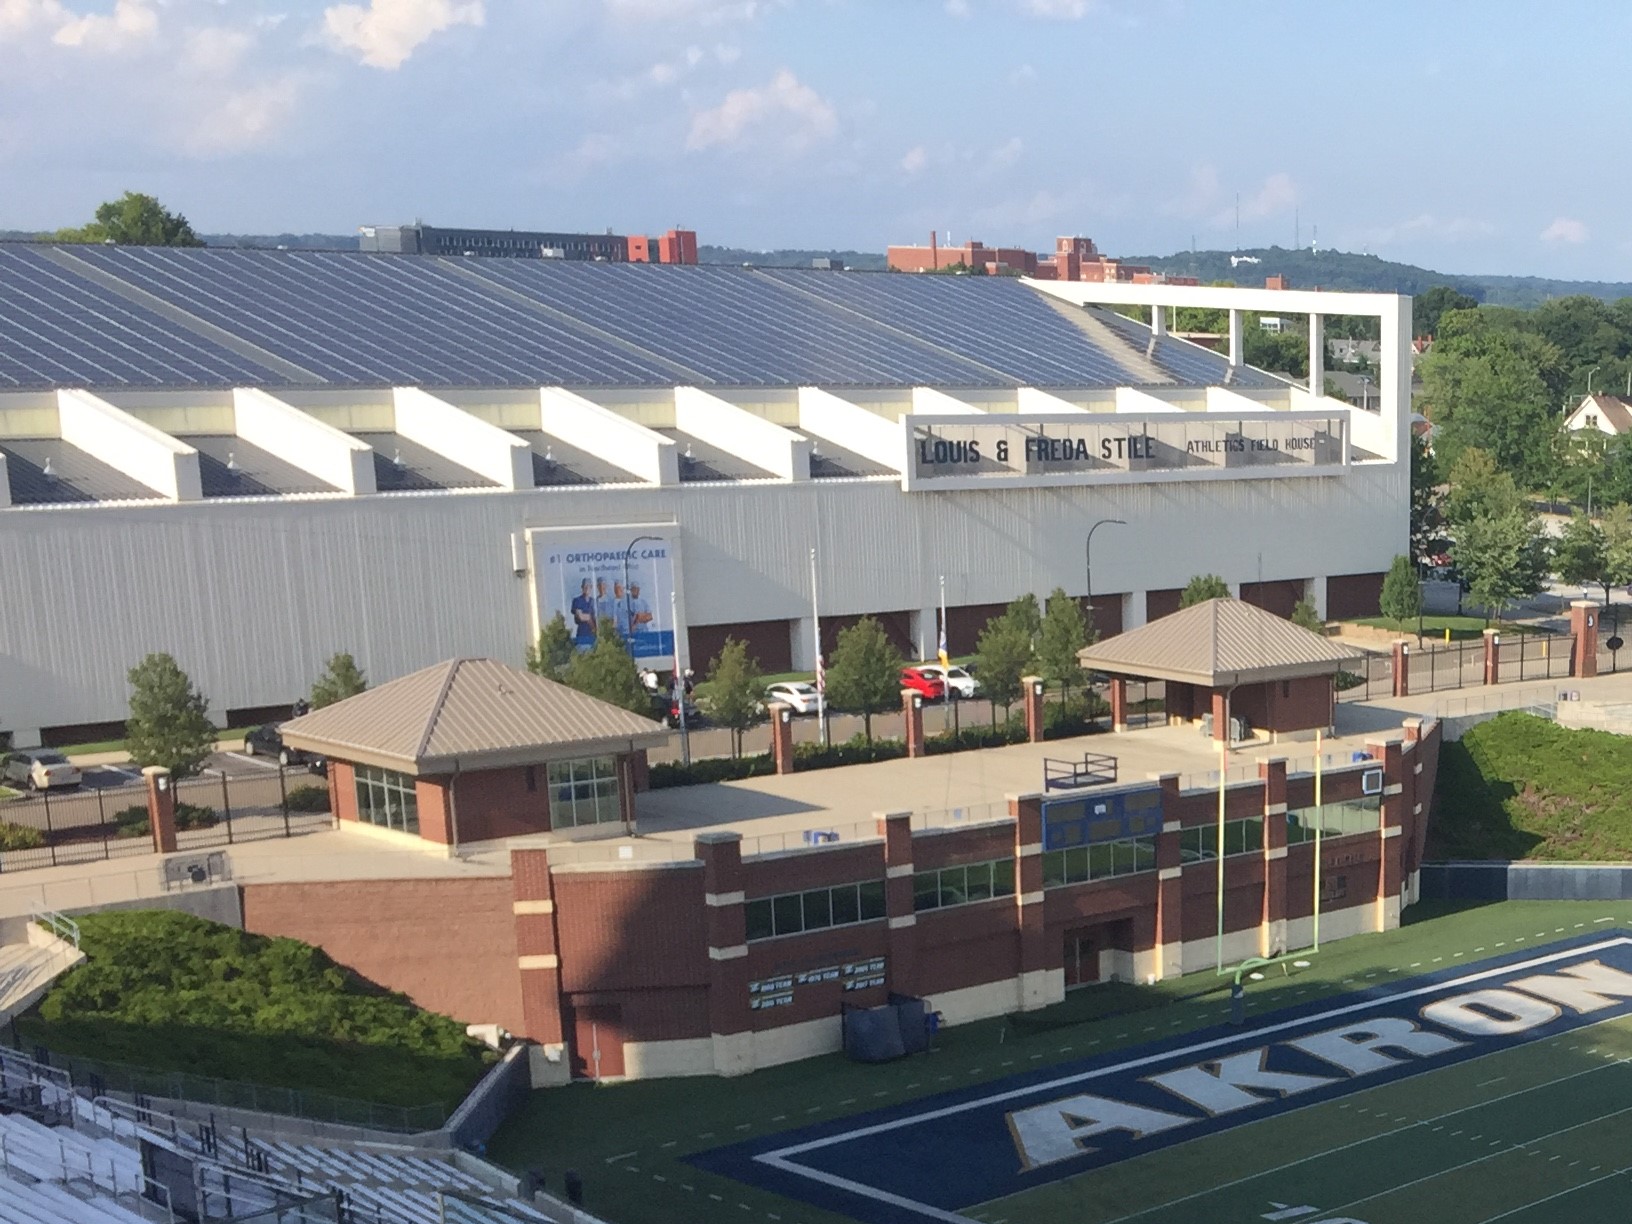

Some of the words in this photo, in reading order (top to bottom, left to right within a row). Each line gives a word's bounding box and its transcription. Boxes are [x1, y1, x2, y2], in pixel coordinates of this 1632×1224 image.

[921, 439, 980, 464] LOUIS
[997, 440, 1008, 462] &
[1026, 438, 1089, 461] FREDA
[1102, 437, 1156, 459] STILE
[1187, 439, 1245, 452] ATHLETICS
[1251, 439, 1278, 451] FIELD
[1286, 437, 1315, 450] HOUSE
[641, 549, 666, 559] CARE
